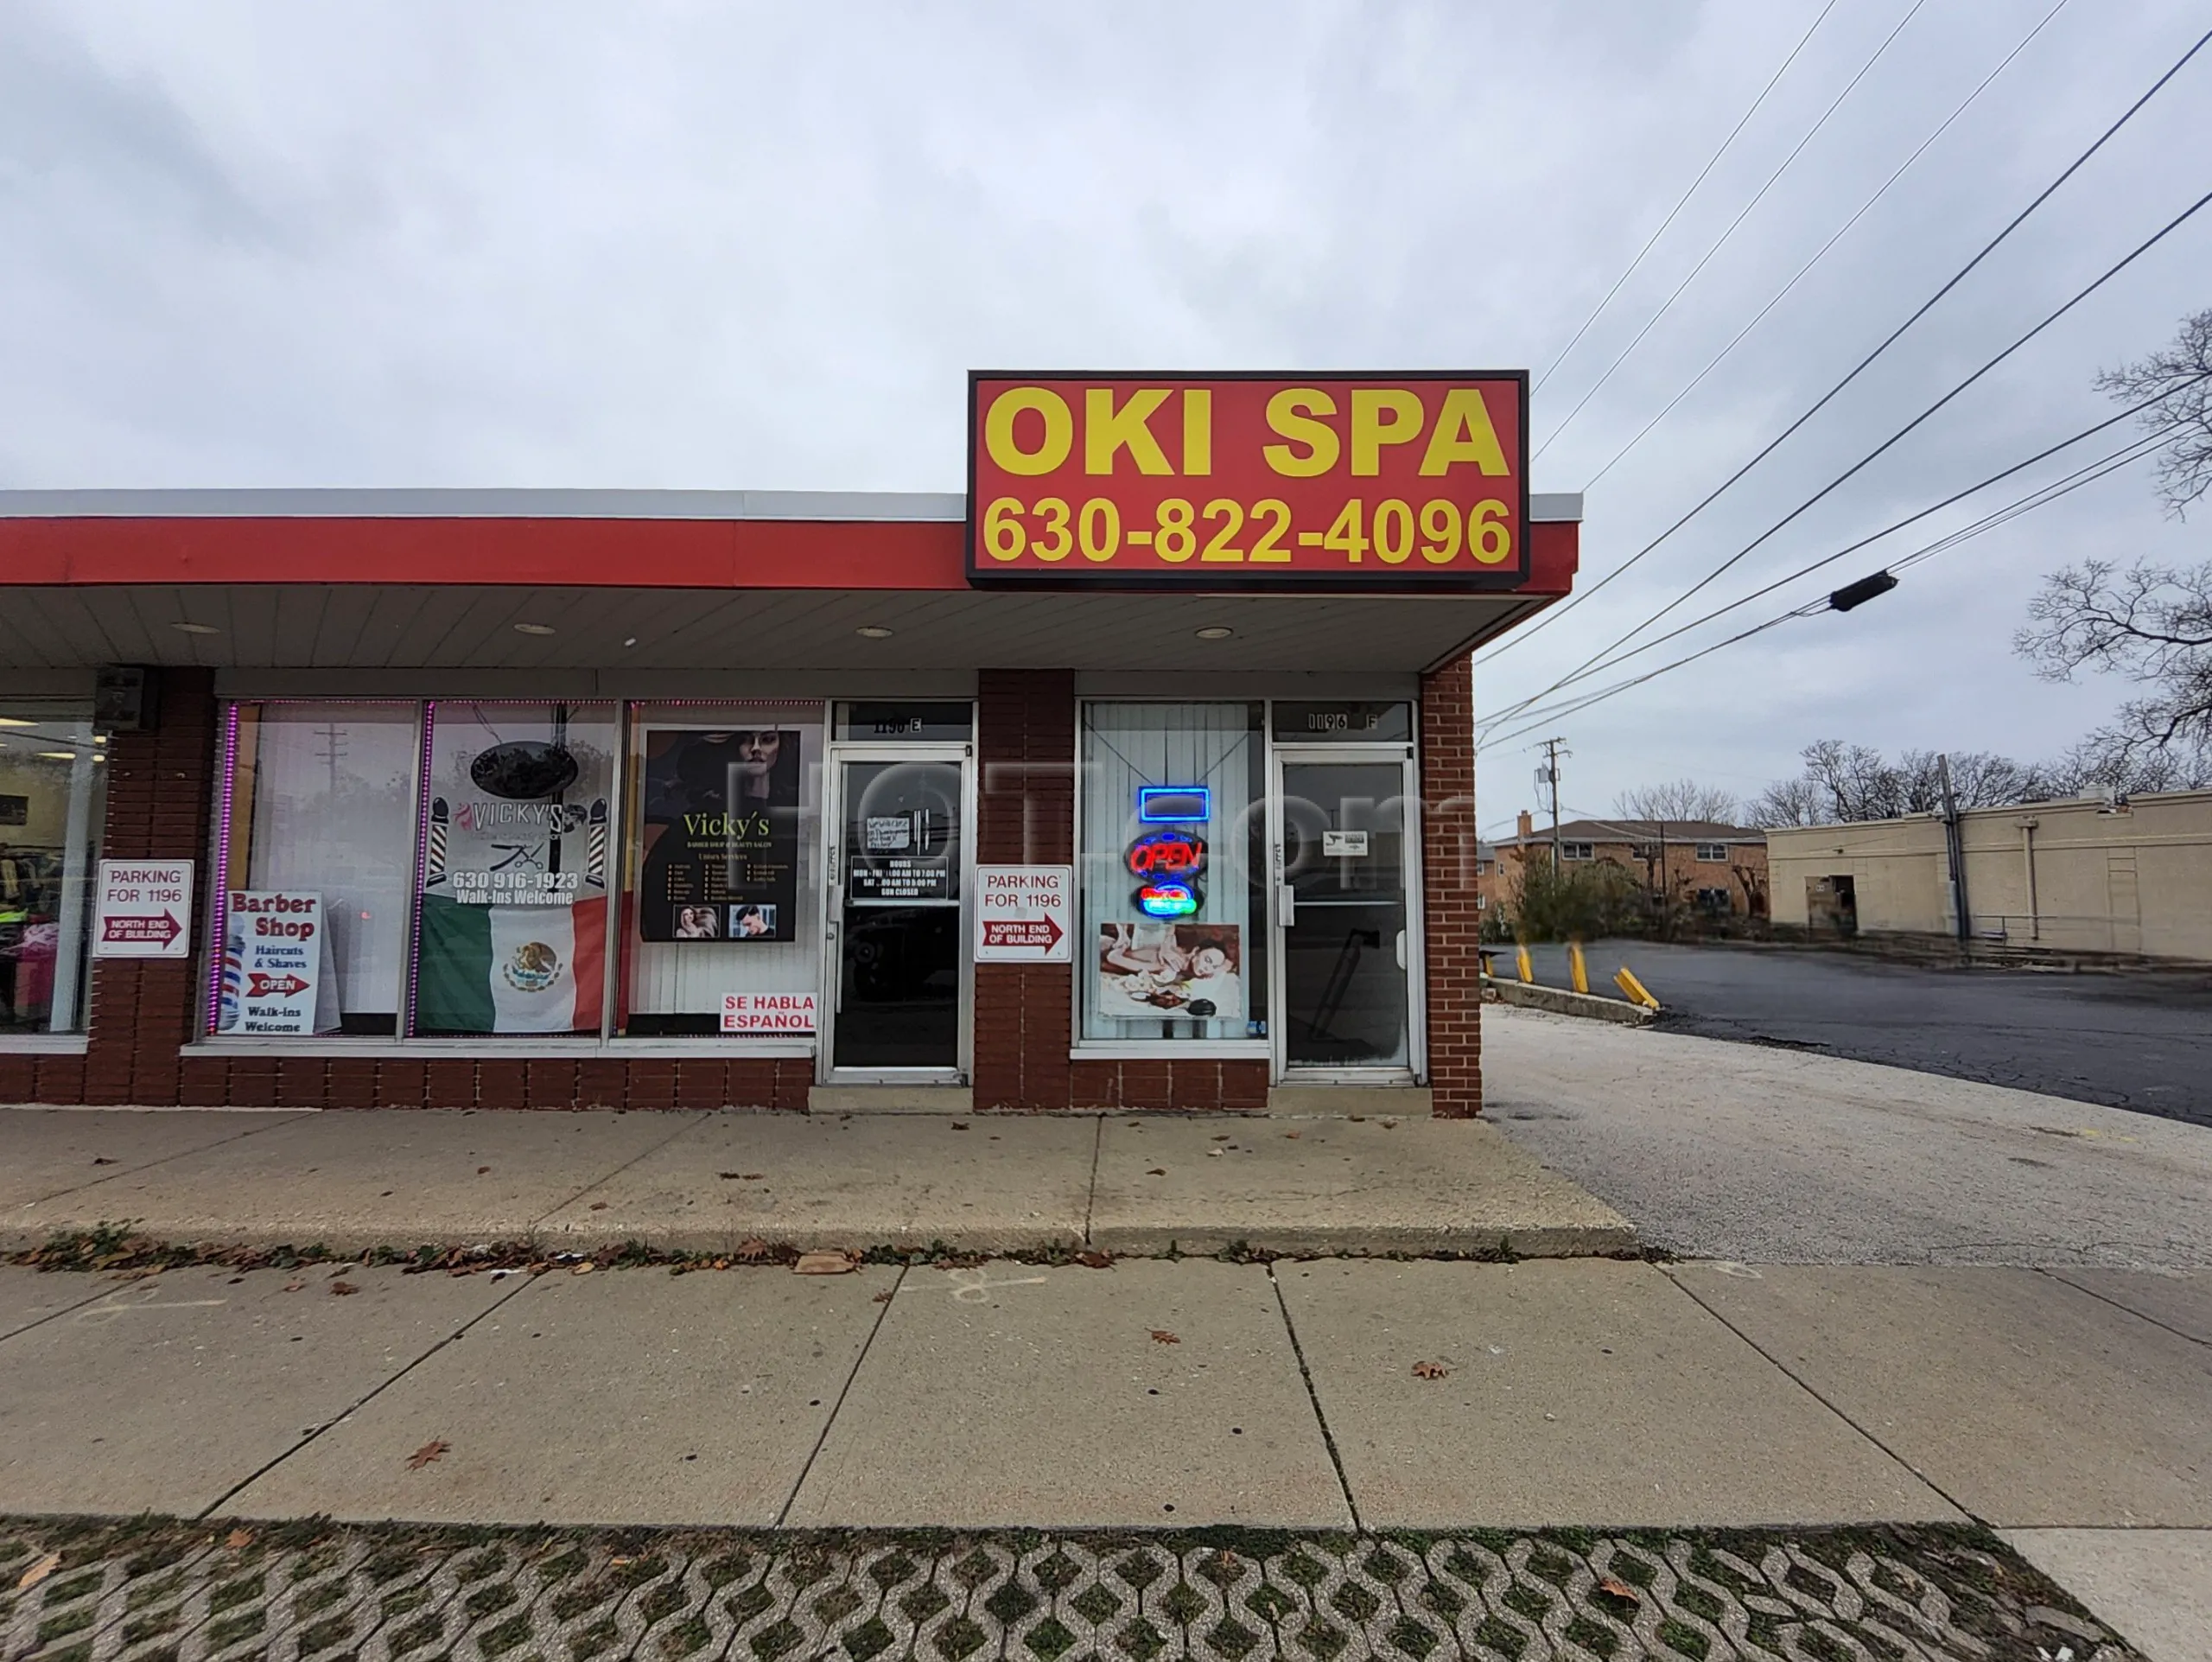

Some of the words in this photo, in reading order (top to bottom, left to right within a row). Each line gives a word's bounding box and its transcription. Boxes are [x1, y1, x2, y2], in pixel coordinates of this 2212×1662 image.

[984, 387, 1211, 476] OKI
[1262, 388, 1510, 477] SPA
[982, 497, 1511, 564] 630-822-4096
[912, 718, 921, 732] E
[1309, 714, 1347, 729] 1196
[1367, 714, 1376, 729] F
[473, 802, 563, 833] VICKY'S
[1130, 842, 1203, 872] OPEN
[111, 870, 181, 883] PARKING
[453, 871, 488, 888] 630
[493, 871, 578, 889] 916-1923
[988, 875, 1058, 888] PARKING
[107, 889, 140, 902] FOR
[147, 889, 182, 902] 1196
[456, 890, 512, 904] Walk-Ins
[514, 890, 574, 905] Welcome
[985, 894, 1019, 907] FOR
[1026, 894, 1061, 907] 1196
[232, 893, 316, 914] Barber
[111, 920, 145, 929] NORTH
[148, 920, 169, 929] END
[255, 917, 315, 941] Shop
[991, 925, 1026, 934] NORTH
[1028, 925, 1050, 934] END
[109, 930, 122, 939] OF
[125, 930, 171, 939] BUILDING
[988, 934, 1003, 944] OF
[1007, 934, 1052, 944] BUILDING
[255, 945, 304, 956] Haircuts
[254, 958, 263, 968] &
[267, 958, 307, 968] Shaves
[260, 979, 296, 990] OPEN
[725, 996, 747, 1009] SE
[753, 996, 814, 1009] HABLA
[724, 1010, 815, 1028] ESPAÑOL
[245, 1022, 301, 1032] Welcome
